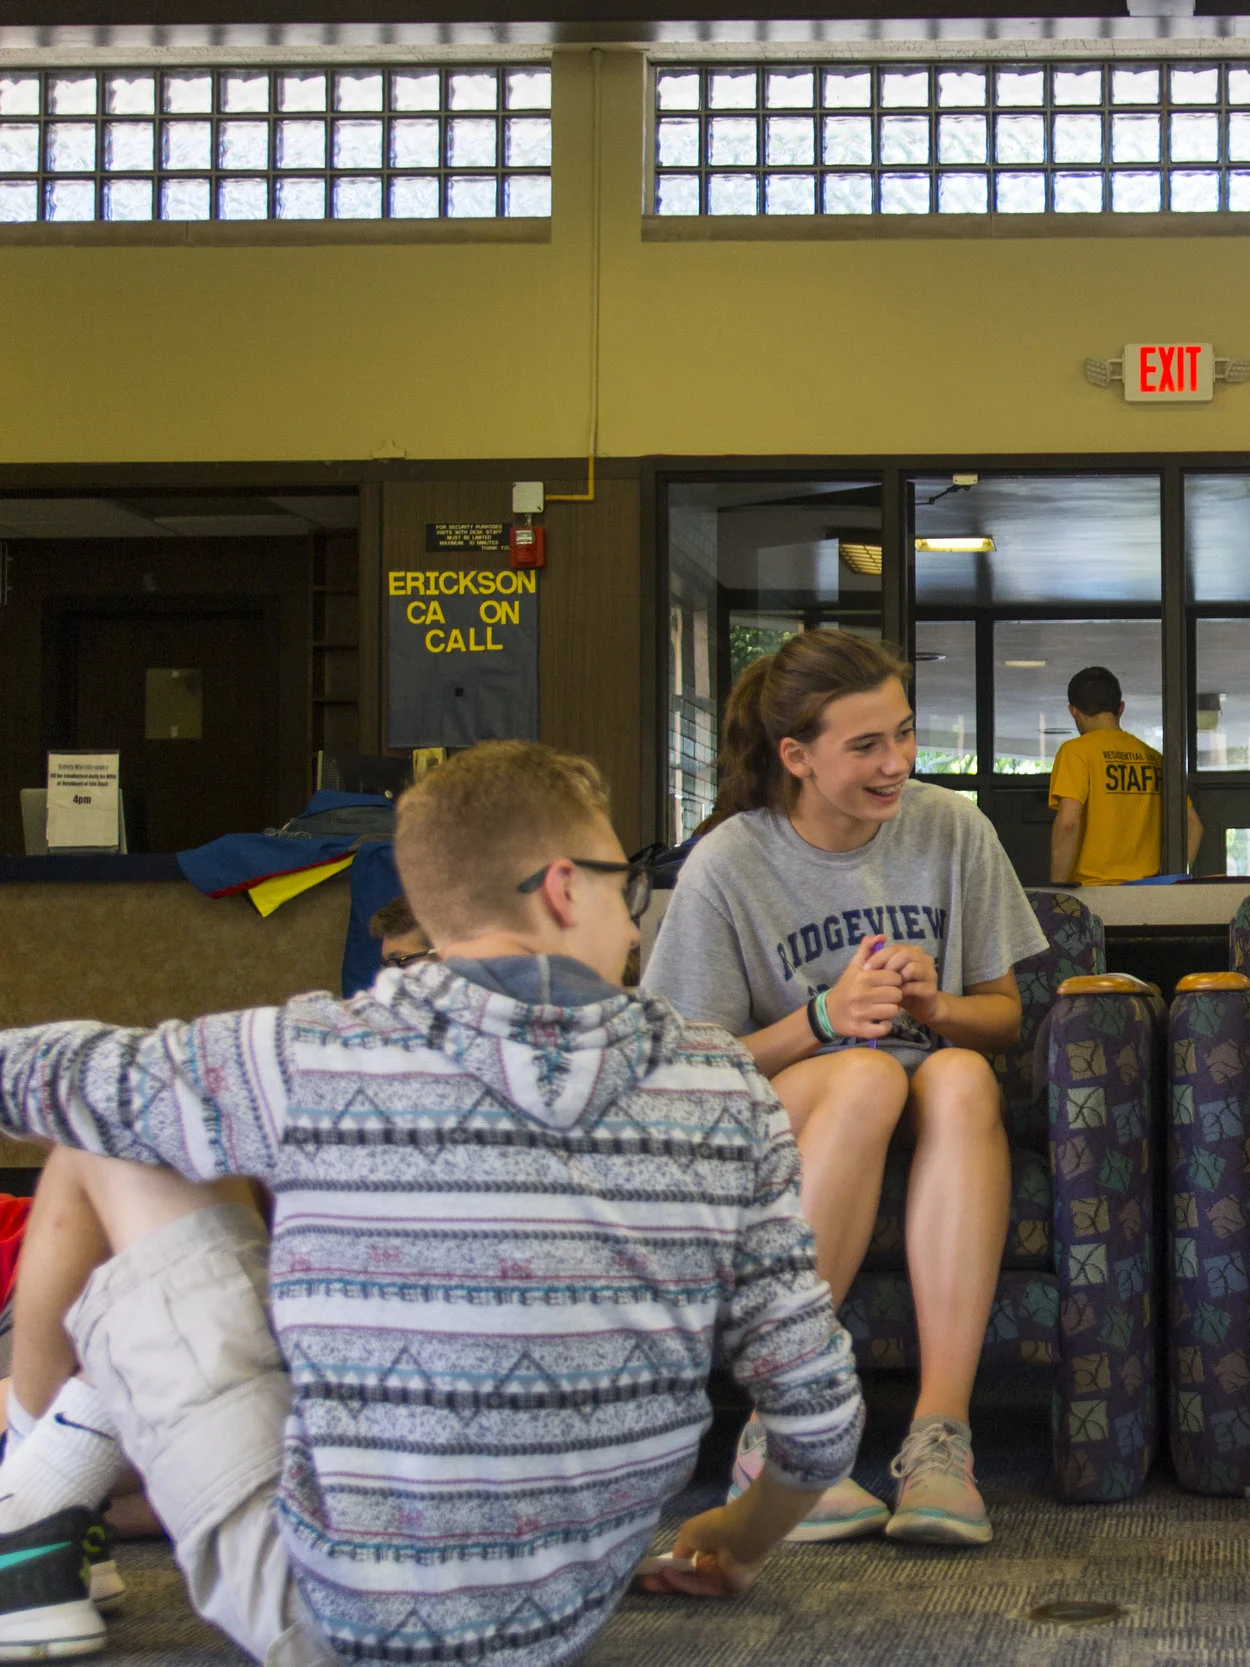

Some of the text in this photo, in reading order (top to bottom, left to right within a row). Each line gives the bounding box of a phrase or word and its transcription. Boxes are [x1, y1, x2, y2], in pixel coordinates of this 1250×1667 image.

[1139, 346, 1202, 392] EXIT
[388, 569, 537, 596] ERICKSON
[406, 599, 520, 625] CA ON
[424, 626, 504, 653] CALL
[1102, 750, 1144, 761] RESIDENTIAL
[72, 794, 92, 805] 4pm
